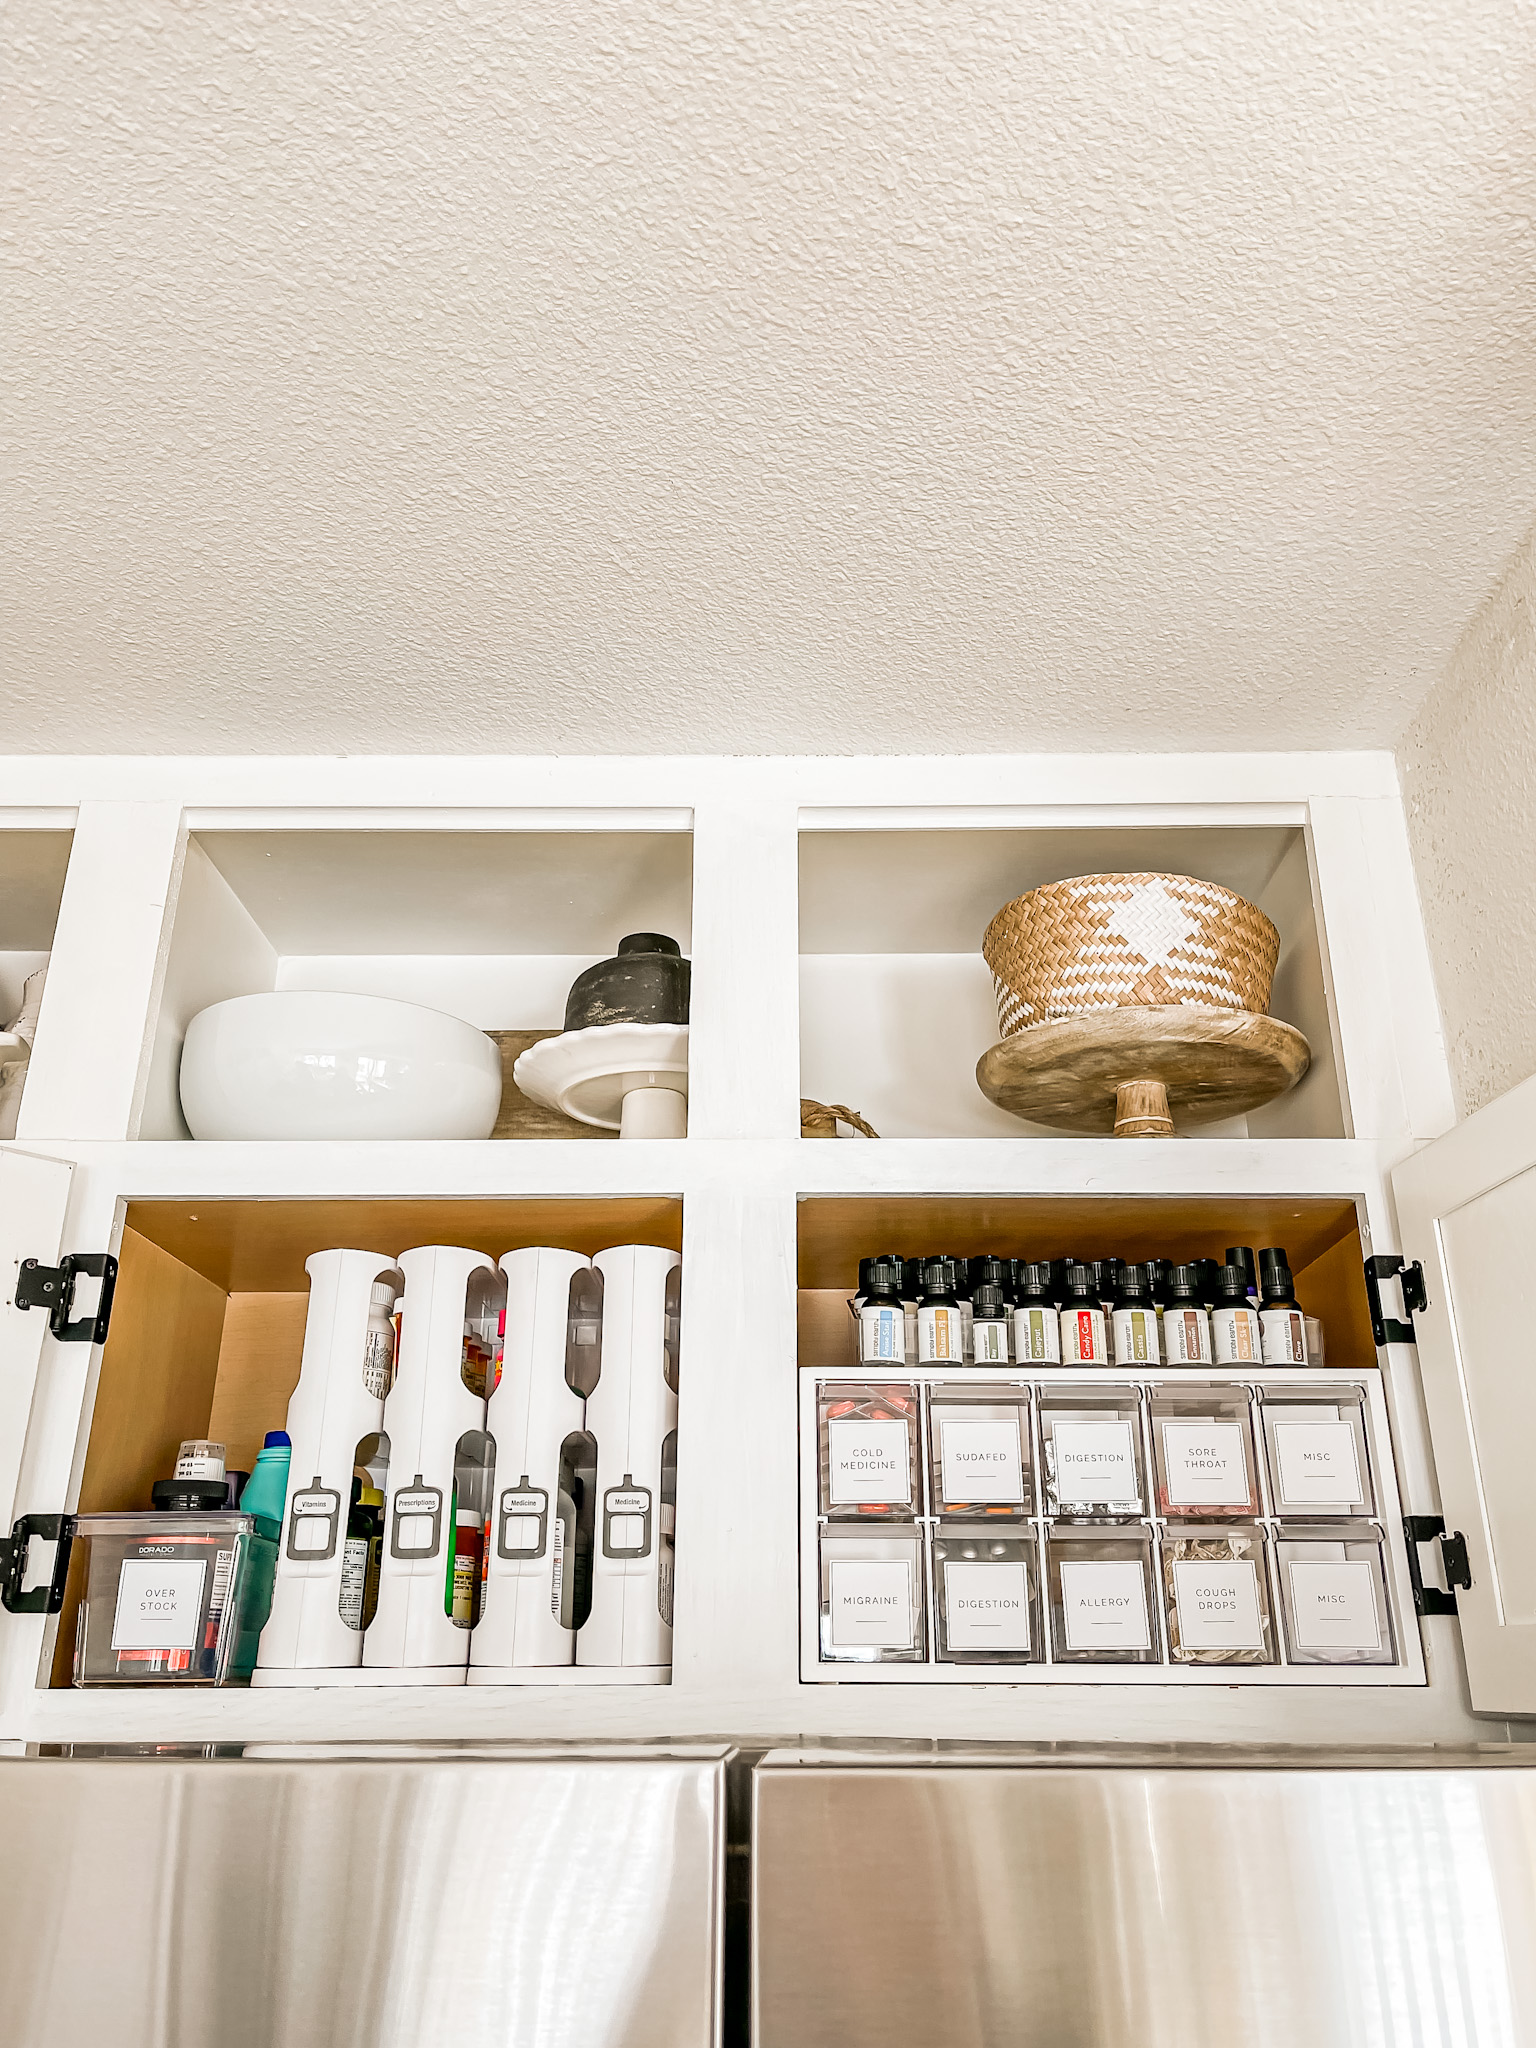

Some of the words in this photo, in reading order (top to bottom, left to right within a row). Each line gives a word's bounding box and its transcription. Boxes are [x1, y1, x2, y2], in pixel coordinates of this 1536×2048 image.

[1034, 1328, 1043, 1357] Cajeput
[1082, 1334, 1092, 1358] Candy
[1241, 1340, 1249, 1358] Clear
[852, 1448, 883, 1457] COLD
[956, 1453, 1007, 1461] SUDAFED
[1188, 1448, 1217, 1457] SORE
[1303, 1452, 1331, 1461] MISC
[1064, 1454, 1124, 1463] DIGESTION
[840, 1461, 896, 1470] MEDICINE
[1184, 1460, 1228, 1469] THROAT
[398, 1499, 436, 1508] Prescriptions
[145, 1589, 176, 1598] OVER
[1195, 1588, 1236, 1597] COUGH
[843, 1596, 898, 1605] MIGRAINE
[1079, 1598, 1130, 1606] ALLERGY
[1317, 1595, 1346, 1604] MISC
[140, 1601, 178, 1611] STOCK
[958, 1600, 1020, 1609] DIGESTION
[1198, 1601, 1237, 1610] DROPS
